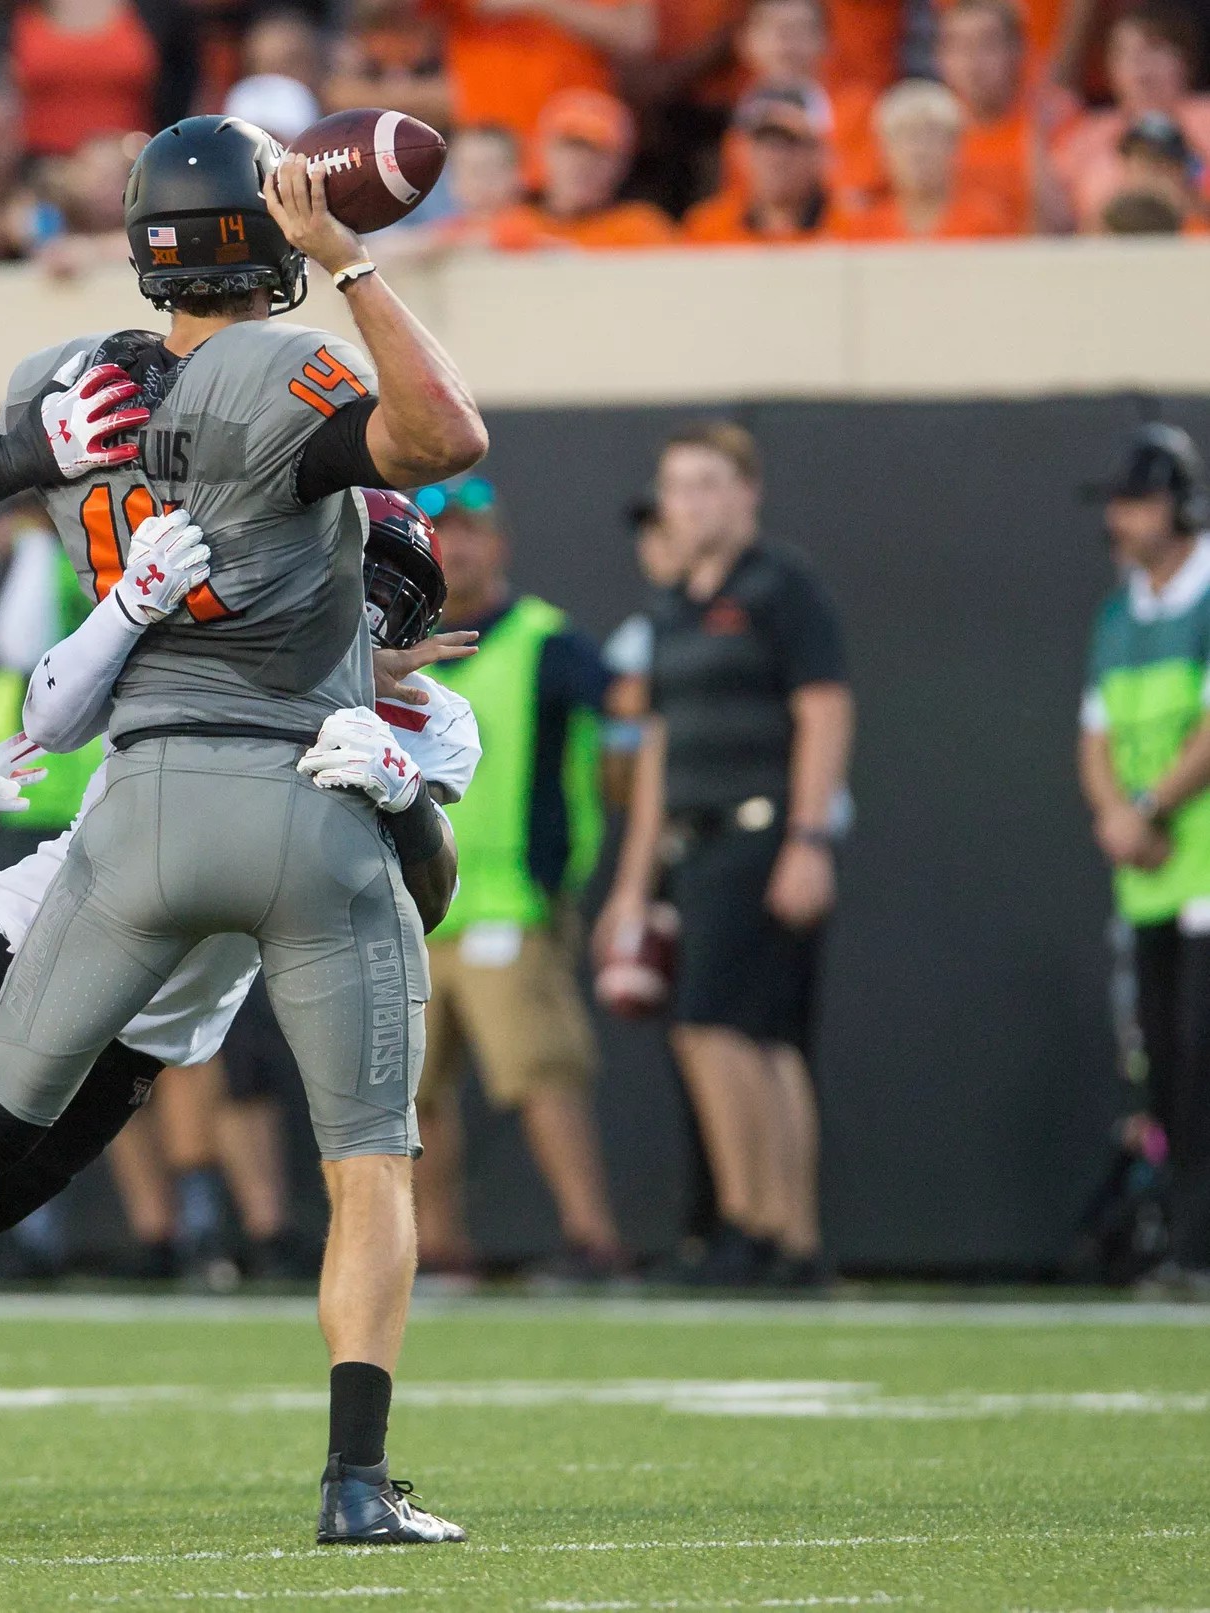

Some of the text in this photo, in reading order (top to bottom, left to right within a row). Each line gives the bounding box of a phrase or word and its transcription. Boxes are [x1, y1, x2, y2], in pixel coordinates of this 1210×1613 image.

[219, 213, 246, 244] 14
[288, 344, 369, 421] 14
[367, 938, 404, 1086] COWBOYS
